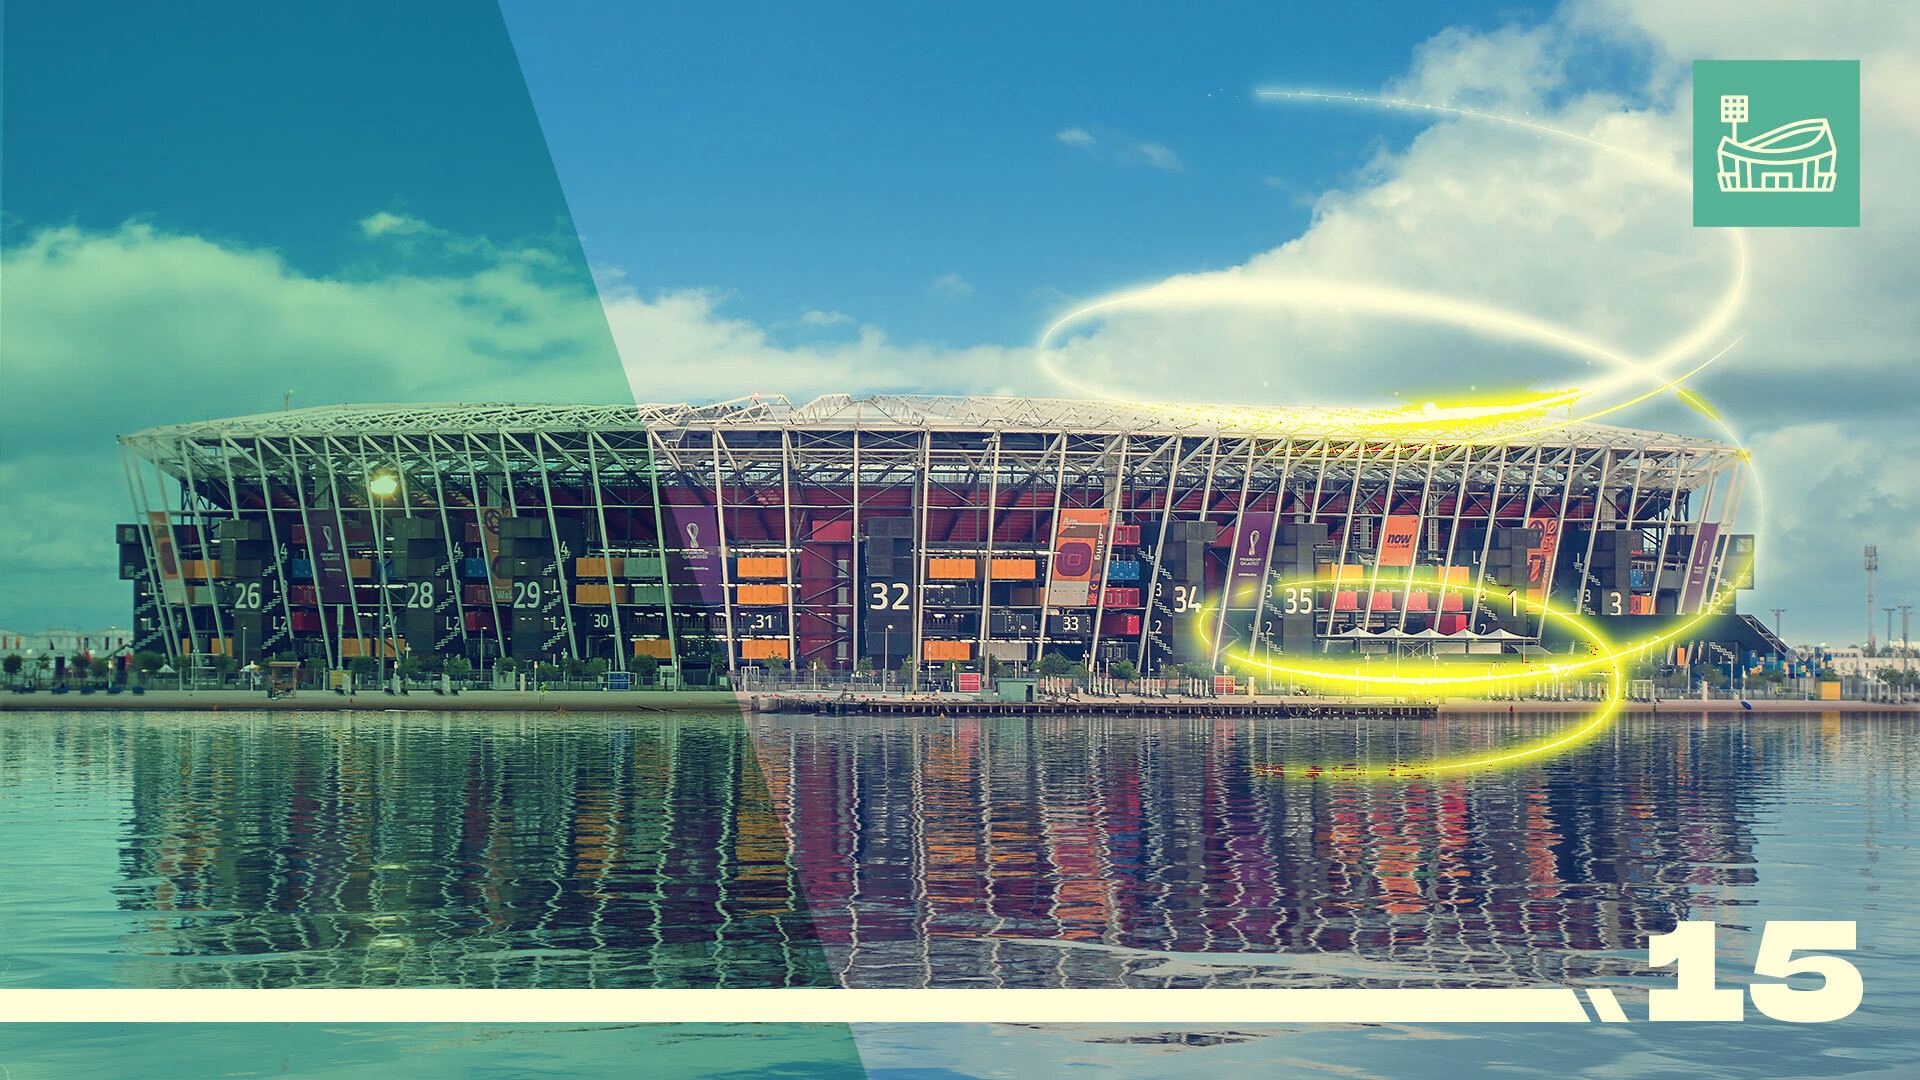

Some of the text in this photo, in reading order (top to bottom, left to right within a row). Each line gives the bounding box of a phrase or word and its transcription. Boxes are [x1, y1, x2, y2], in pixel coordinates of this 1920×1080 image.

[1387, 534, 1412, 544] now
[235, 582, 260, 608] 26
[407, 582, 433, 608] 28
[514, 582, 540, 608] 29
[870, 582, 910, 610] 32
[1174, 586, 1201, 613] 34
[1285, 588, 1312, 614] 35
[1508, 590, 1518, 616] 1
[1610, 592, 1622, 615] 3
[446, 616, 460, 630] L2
[594, 614, 608, 628] 30
[756, 614, 772, 628] 31
[1063, 616, 1079, 630] 33
